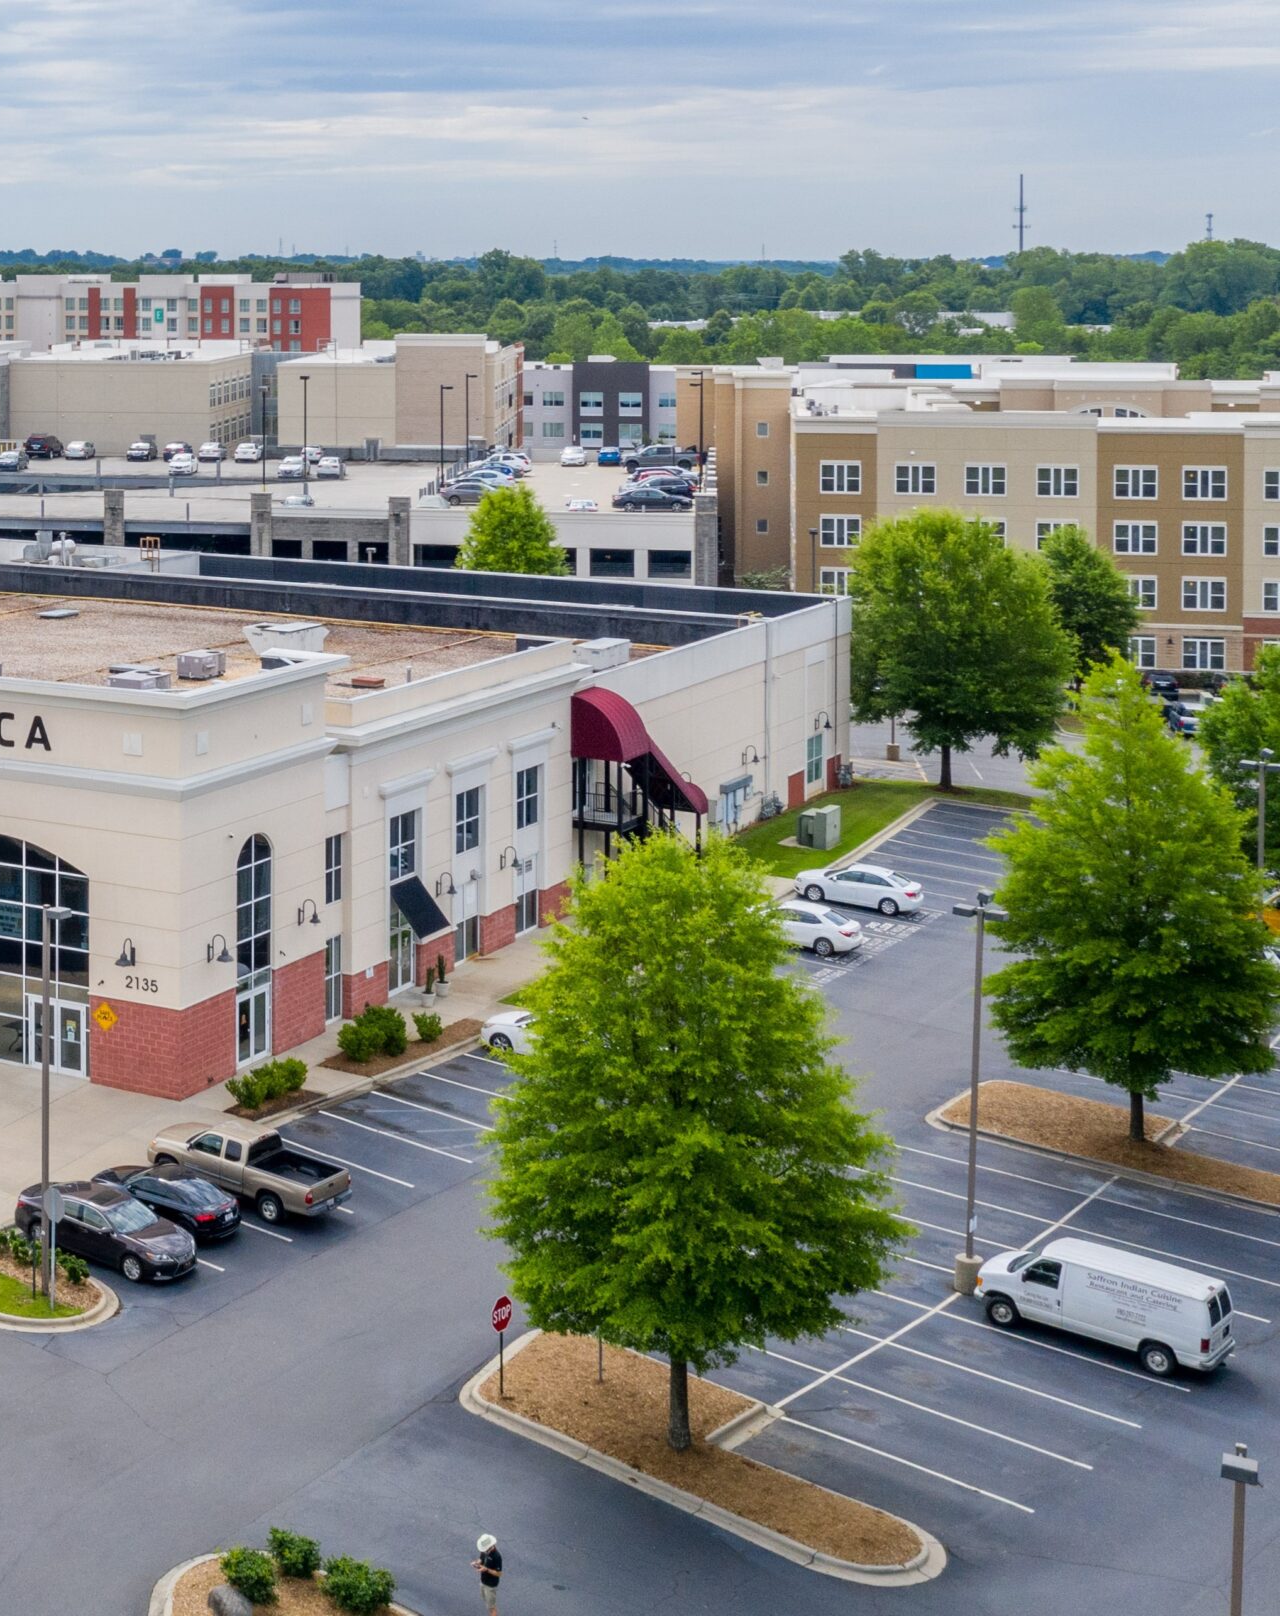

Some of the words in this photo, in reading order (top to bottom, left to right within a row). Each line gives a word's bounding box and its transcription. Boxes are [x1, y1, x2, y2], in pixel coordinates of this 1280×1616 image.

[125, 975, 159, 993] 2135
[1087, 1272, 1118, 1287] Saffron
[1120, 1281, 1148, 1295] Indian
[1150, 1288, 1183, 1304] Cuisine
[1089, 1280, 1128, 1297] Restaurant
[1145, 1297, 1178, 1311] Catering
[493, 1304, 511, 1324] STOP
